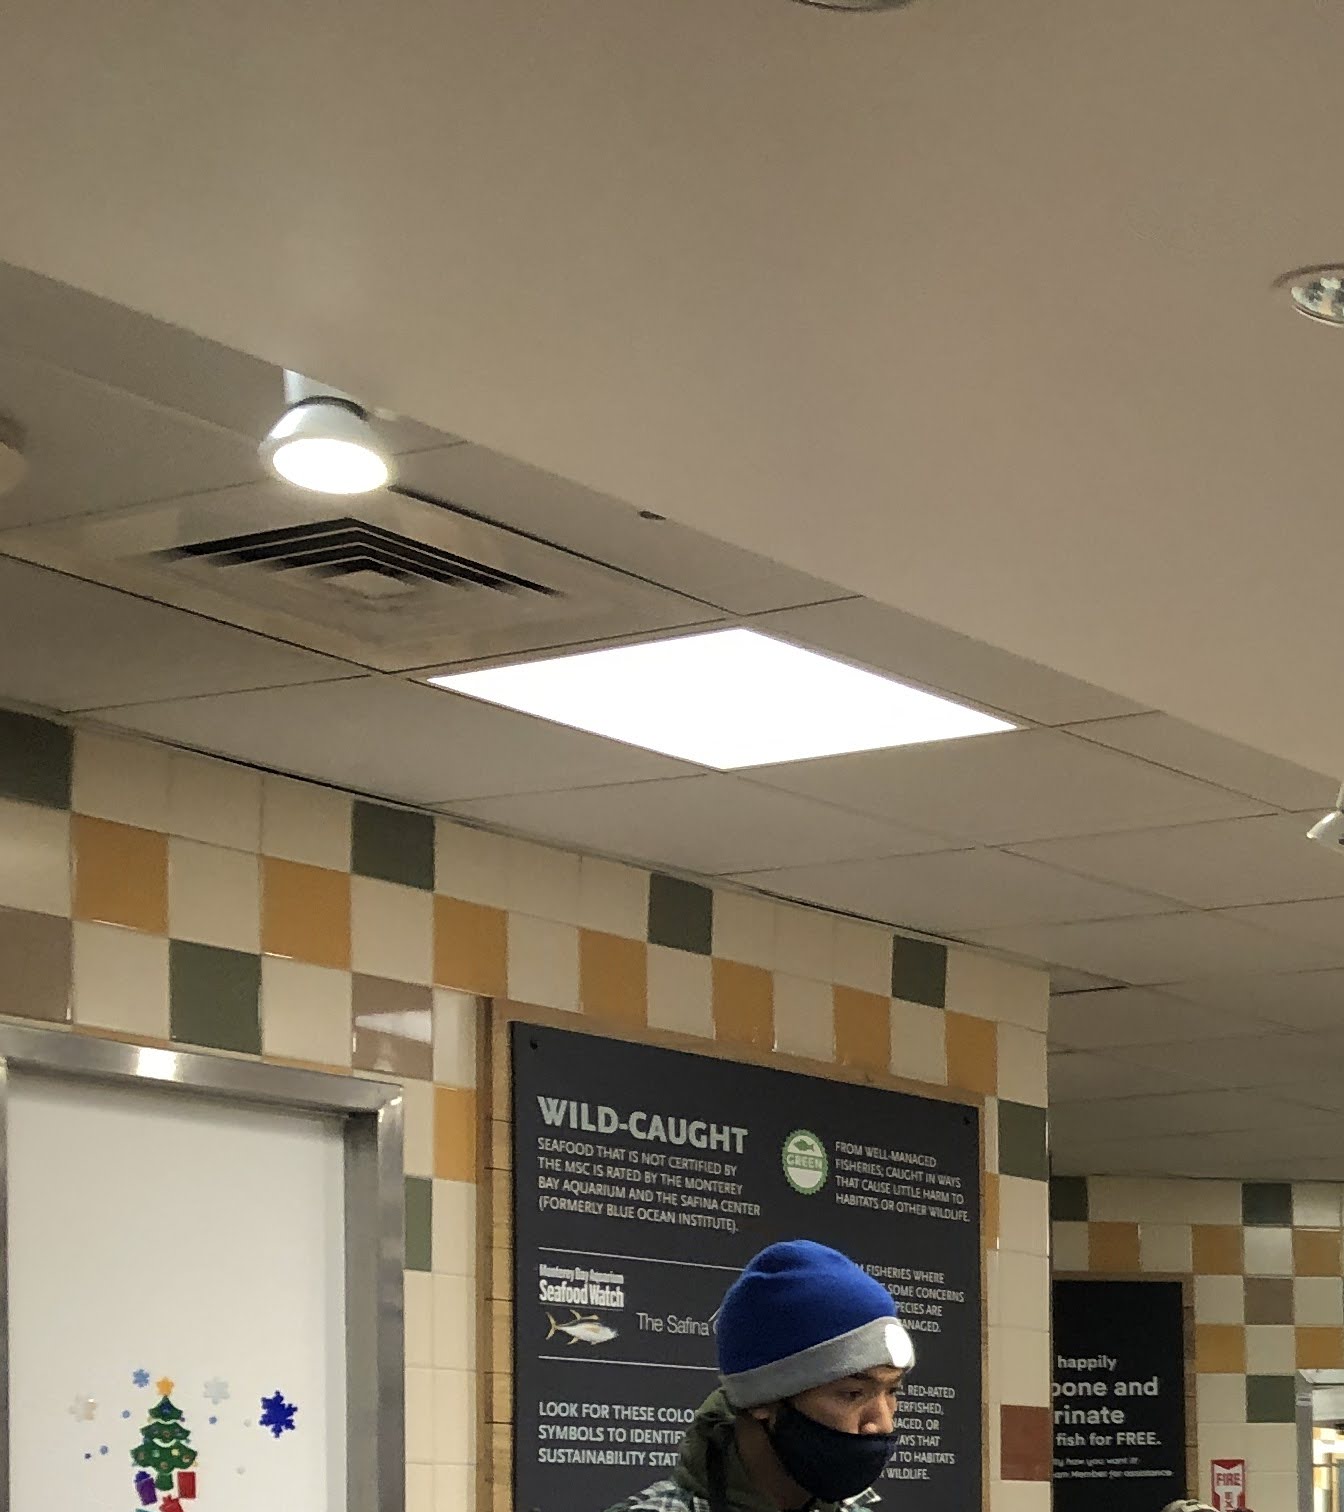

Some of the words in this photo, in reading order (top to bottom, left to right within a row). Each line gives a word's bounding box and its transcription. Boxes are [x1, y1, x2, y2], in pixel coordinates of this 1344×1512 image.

[537, 1095, 748, 1154] WILD-CAUGHT
[537, 1137, 594, 1157] SEAFOOD
[597, 1145, 626, 1161] THAT
[629, 1149, 639, 1164] IS
[641, 1152, 666, 1168] NOT
[668, 1156, 722, 1176] CERTIFIED
[724, 1163, 738, 1177] BY
[787, 1154, 823, 1170] GREEN
[835, 1141, 863, 1155] FROM
[865, 1146, 937, 1168] WELL-MANAGED
[537, 1156, 561, 1172] THE
[565, 1160, 590, 1176] MSC
[593, 1163, 604, 1178] IS
[606, 1165, 641, 1183] RATED
[644, 1171, 657, 1184] BY
[660, 1173, 682, 1188] THE
[684, 1175, 743, 1197] MONTEREY
[886, 1166, 924, 1183] CAUGHT
[925, 1173, 936, 1184] IN
[937, 1174, 962, 1188] WAYS
[538, 1176, 559, 1191] BAY
[563, 1178, 626, 1199] AQUARIUM
[629, 1188, 654, 1202] AND
[656, 1191, 678, 1207] THE
[681, 1194, 718, 1211] SAFINA
[720, 1200, 761, 1217] CENTER
[835, 1175, 860, 1189] THAT
[861, 1179, 891, 1195] CAUSE
[893, 1184, 921, 1199] LITTLE
[923, 1188, 950, 1203] HARM
[952, 1193, 965, 1206] TO
[538, 1195, 604, 1216] (FORMERLY
[606, 1204, 635, 1220] BLUE
[637, 1207, 676, 1225] OCEAN
[678, 1212, 739, 1235] INSTITUTE).
[835, 1193, 879, 1210] HABITATS
[880, 1198, 895, 1211] OR
[896, 1200, 927, 1216] OTHER
[928, 1206, 971, 1223] WILDLIFE.
[866, 1264, 912, 1281] FISHERIES
[913, 1270, 945, 1284] WHERE
[539, 1279, 588, 1305] Seafood
[589, 1284, 624, 1308] Watch
[887, 1283, 914, 1297] SOME
[915, 1286, 965, 1303] CONCERNS
[894, 1301, 925, 1315] PECIES
[925, 1304, 943, 1317] ARE
[636, 1312, 663, 1332] The
[667, 1314, 709, 1336] Safina
[1057, 1354, 1117, 1371] happily
[907, 1384, 956, 1399] RED-RATED
[1113, 1375, 1159, 1397] and
[538, 1401, 579, 1418] LOOK
[581, 1403, 609, 1419] FOR
[612, 1405, 655, 1421] THESE
[657, 1408, 696, 1423] COLO
[1054, 1404, 1125, 1425] rinate
[538, 1425, 605, 1442] SYMBOLS
[607, 1427, 627, 1443] TO
[926, 1418, 940, 1431] OR
[898, 1434, 916, 1447] AYS
[917, 1435, 941, 1447] THAT
[1055, 1432, 1086, 1447] fish
[1089, 1432, 1113, 1446] for
[1116, 1431, 1162, 1446] FREE.
[538, 1448, 646, 1465] SUSTAINABILITY
[648, 1452, 682, 1467] STAT
[898, 1451, 912, 1463] TO
[914, 1451, 956, 1465] HABITATS
[886, 1467, 930, 1480] WILDLIFE.
[1216, 1473, 1241, 1486] FIRE
